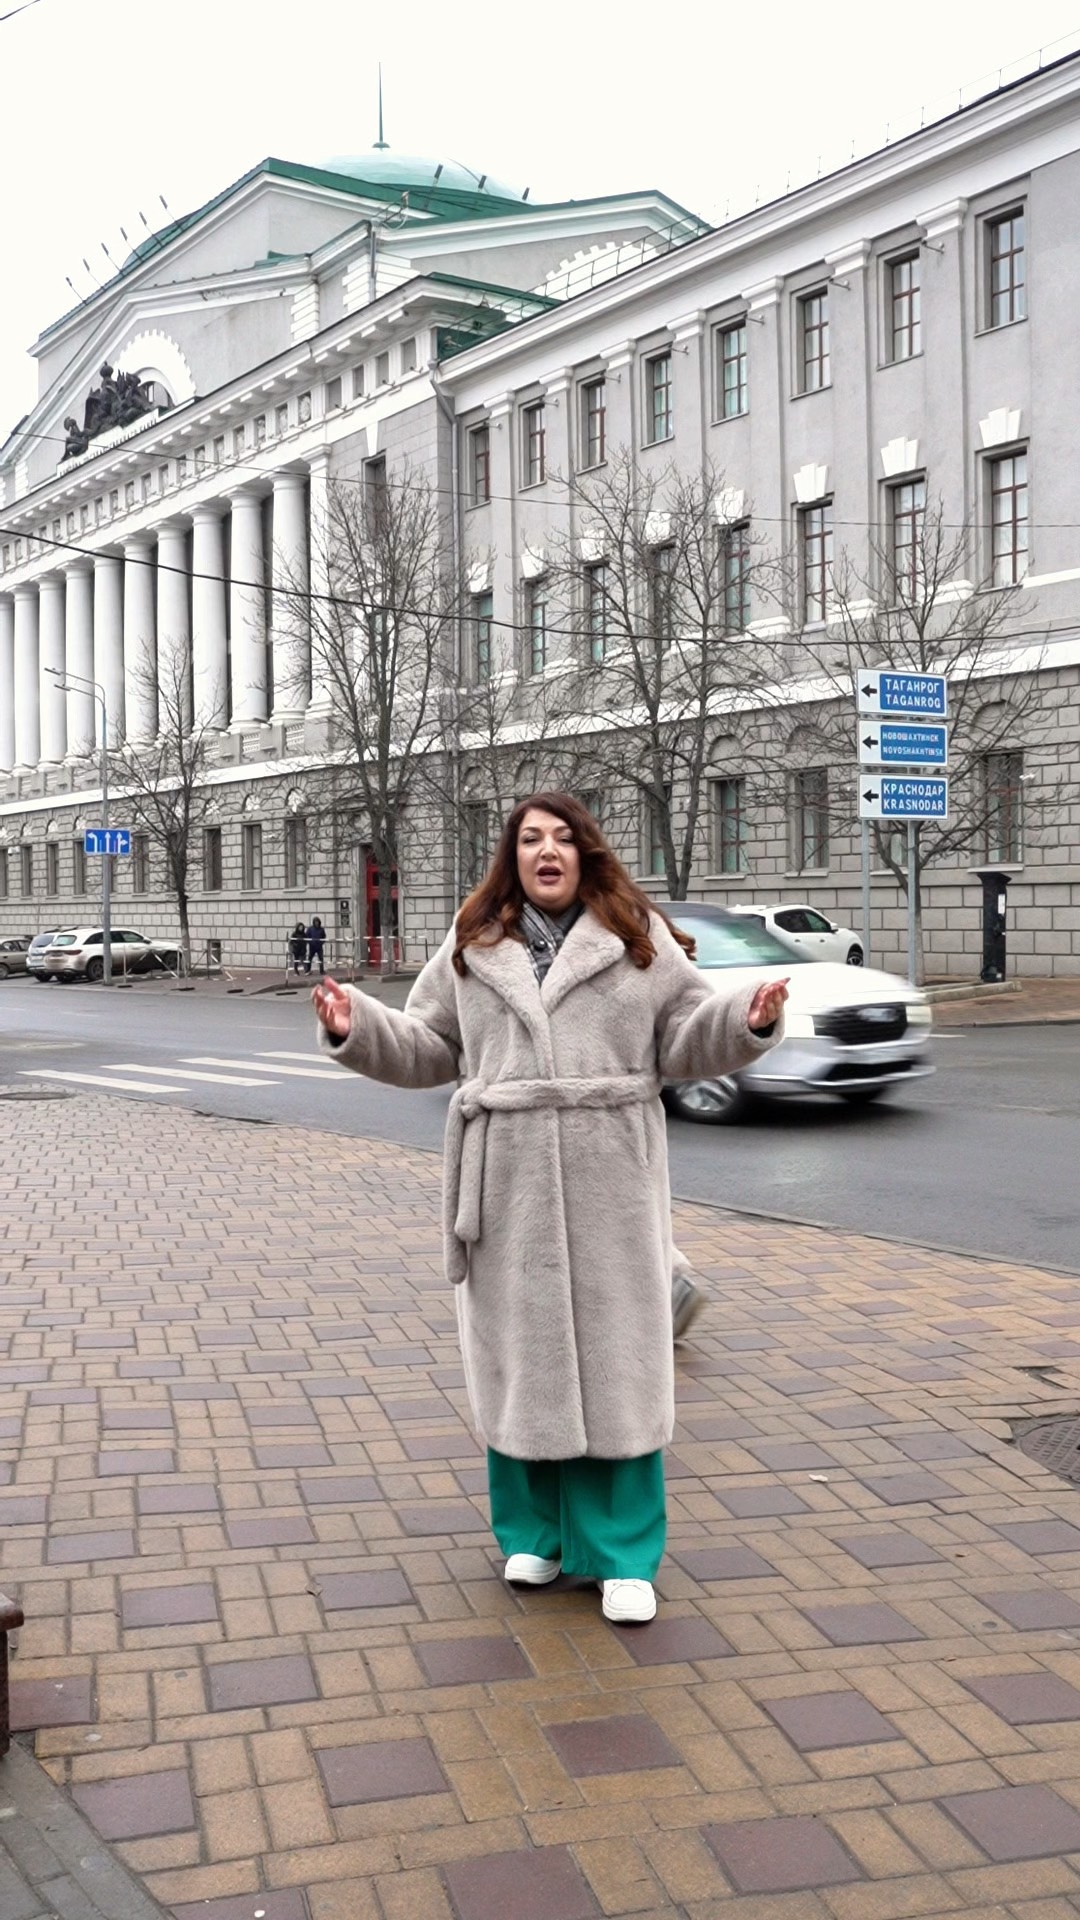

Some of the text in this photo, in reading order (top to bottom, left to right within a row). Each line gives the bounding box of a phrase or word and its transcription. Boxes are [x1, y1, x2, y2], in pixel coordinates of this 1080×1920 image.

[885, 679, 940, 693] ТАГАНРОГ
[887, 695, 941, 708] TAGANROG
[884, 783, 944, 797] КРАСНОДАР
[884, 799, 944, 811] KRASNODAR
